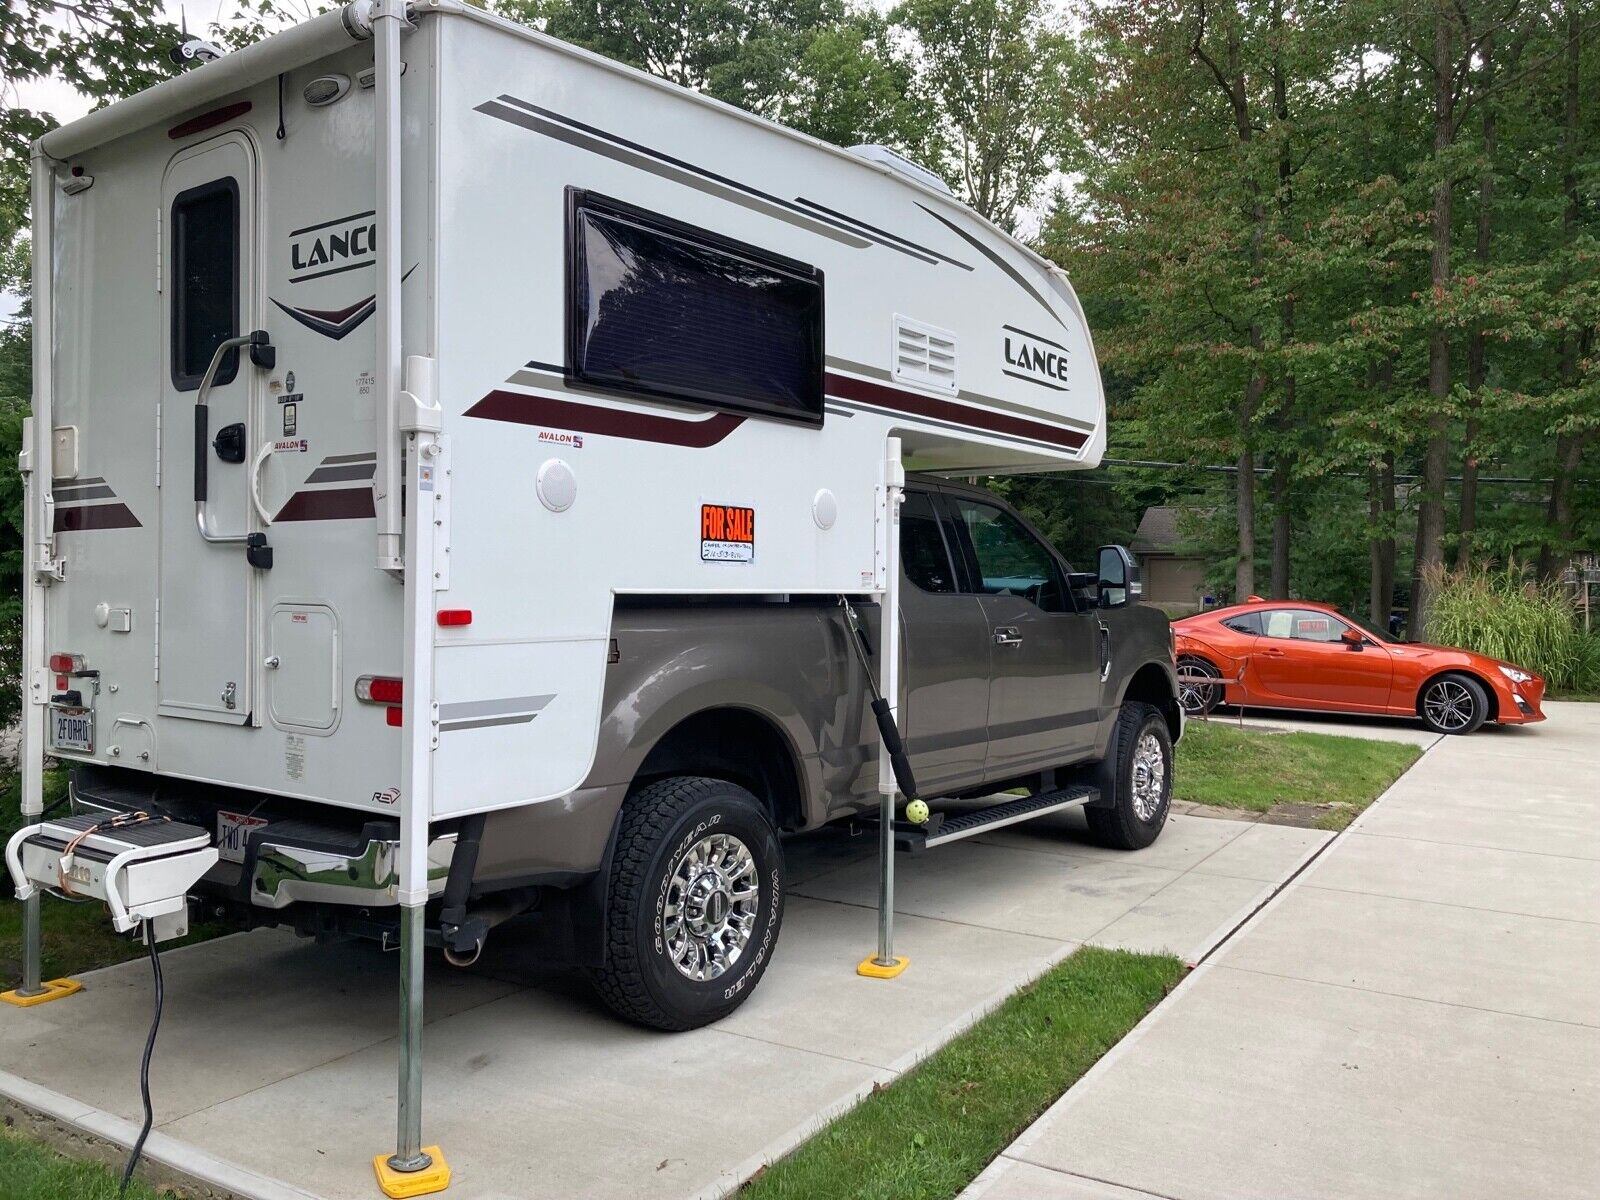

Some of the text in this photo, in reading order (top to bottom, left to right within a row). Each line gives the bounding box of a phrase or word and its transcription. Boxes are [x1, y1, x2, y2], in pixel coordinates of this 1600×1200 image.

[1005, 337, 1067, 382] LANCE
[274, 441, 299, 450] AVALON
[538, 431, 572, 443] AVALON
[703, 506, 753, 541] FOR SALE
[654, 814, 721, 955] GOODYEAR
[724, 868, 779, 999] WRANGLER
